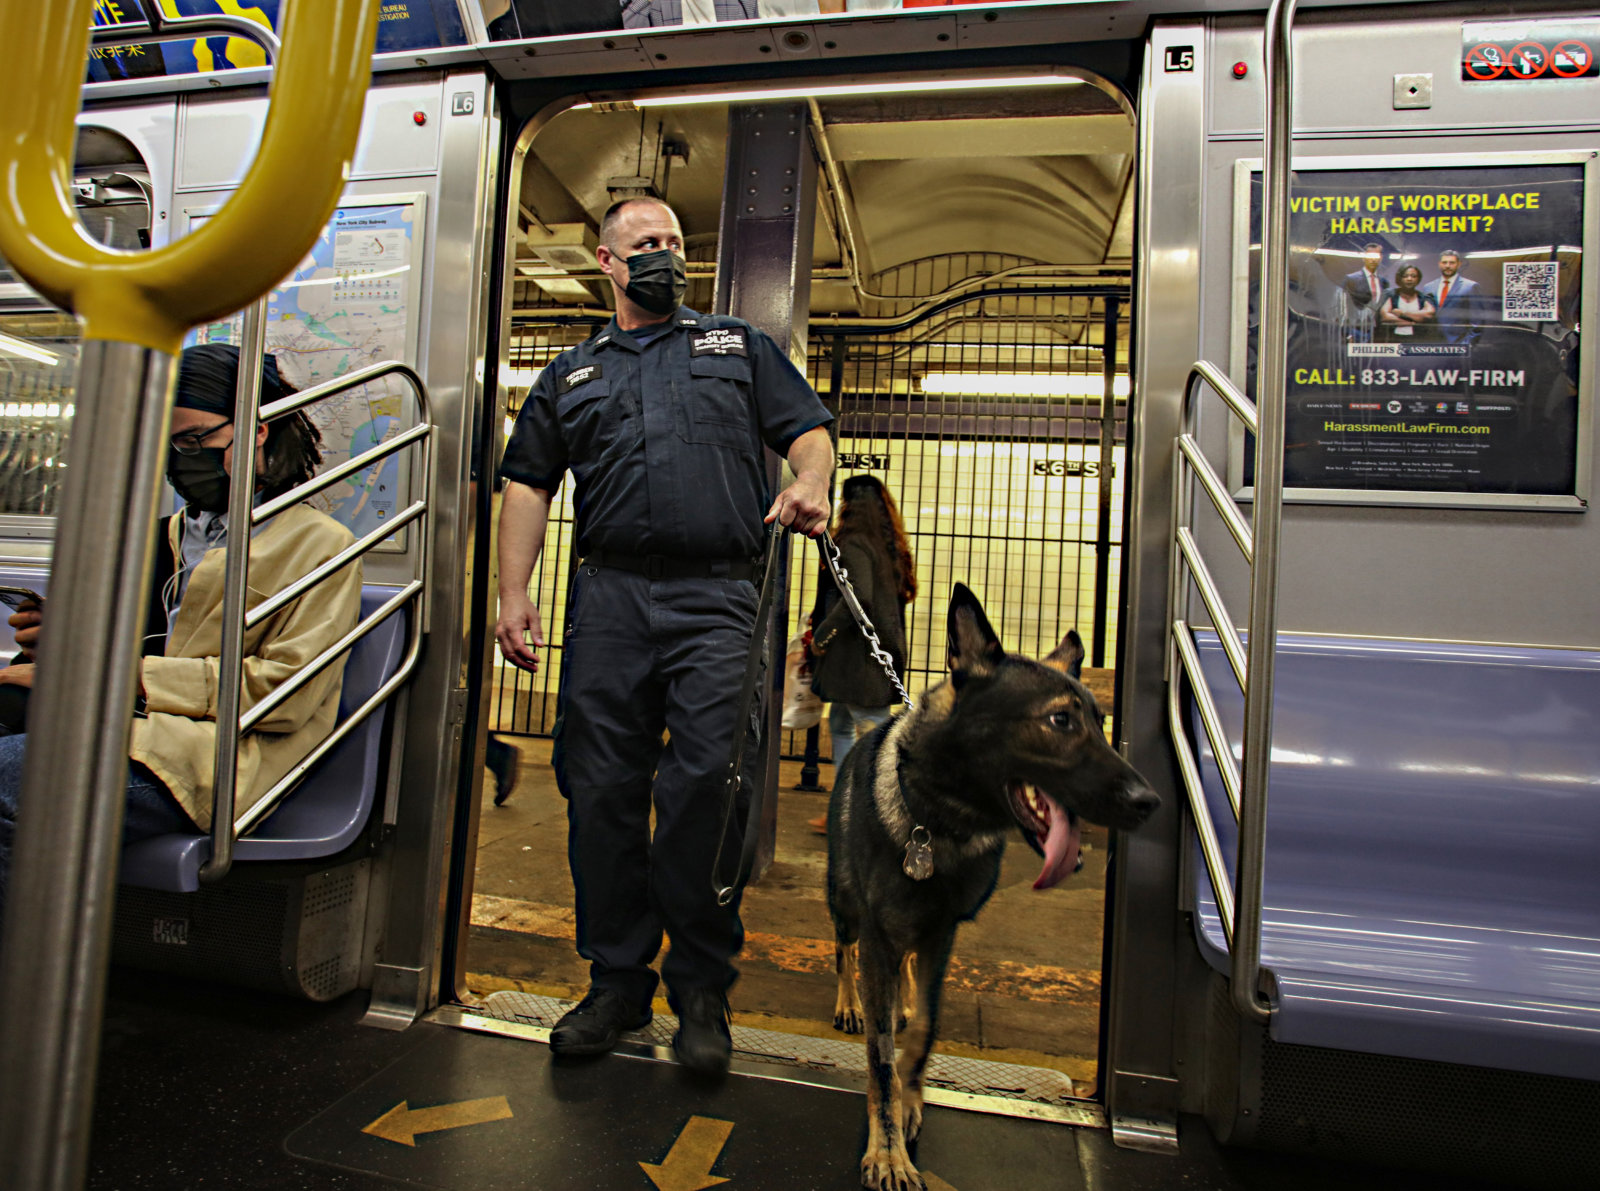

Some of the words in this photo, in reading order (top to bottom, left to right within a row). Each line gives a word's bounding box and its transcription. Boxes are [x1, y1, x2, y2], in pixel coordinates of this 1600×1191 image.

[382, 4, 407, 13] BUREAU
[1166, 51, 1193, 70] L5
[453, 96, 474, 113] L6
[1290, 196, 1360, 213] VICTIM
[1366, 195, 1394, 212] OF
[1399, 192, 1540, 211] WORKPLACE
[1331, 215, 1495, 234] HARASSMENT?
[1507, 311, 1529, 319] SCAN
[1530, 311, 1553, 319] HERE
[706, 329, 729, 337] NYPD
[694, 335, 743, 347] POLICE
[1351, 346, 1395, 354] PHILLIPS
[1409, 346, 1467, 354] ASSOCIATES
[1294, 368, 1356, 385] CALL:
[1361, 369, 1525, 387] 833-LAW-FIRM
[1324, 421, 1490, 434] HarassmentLawFirm.com
